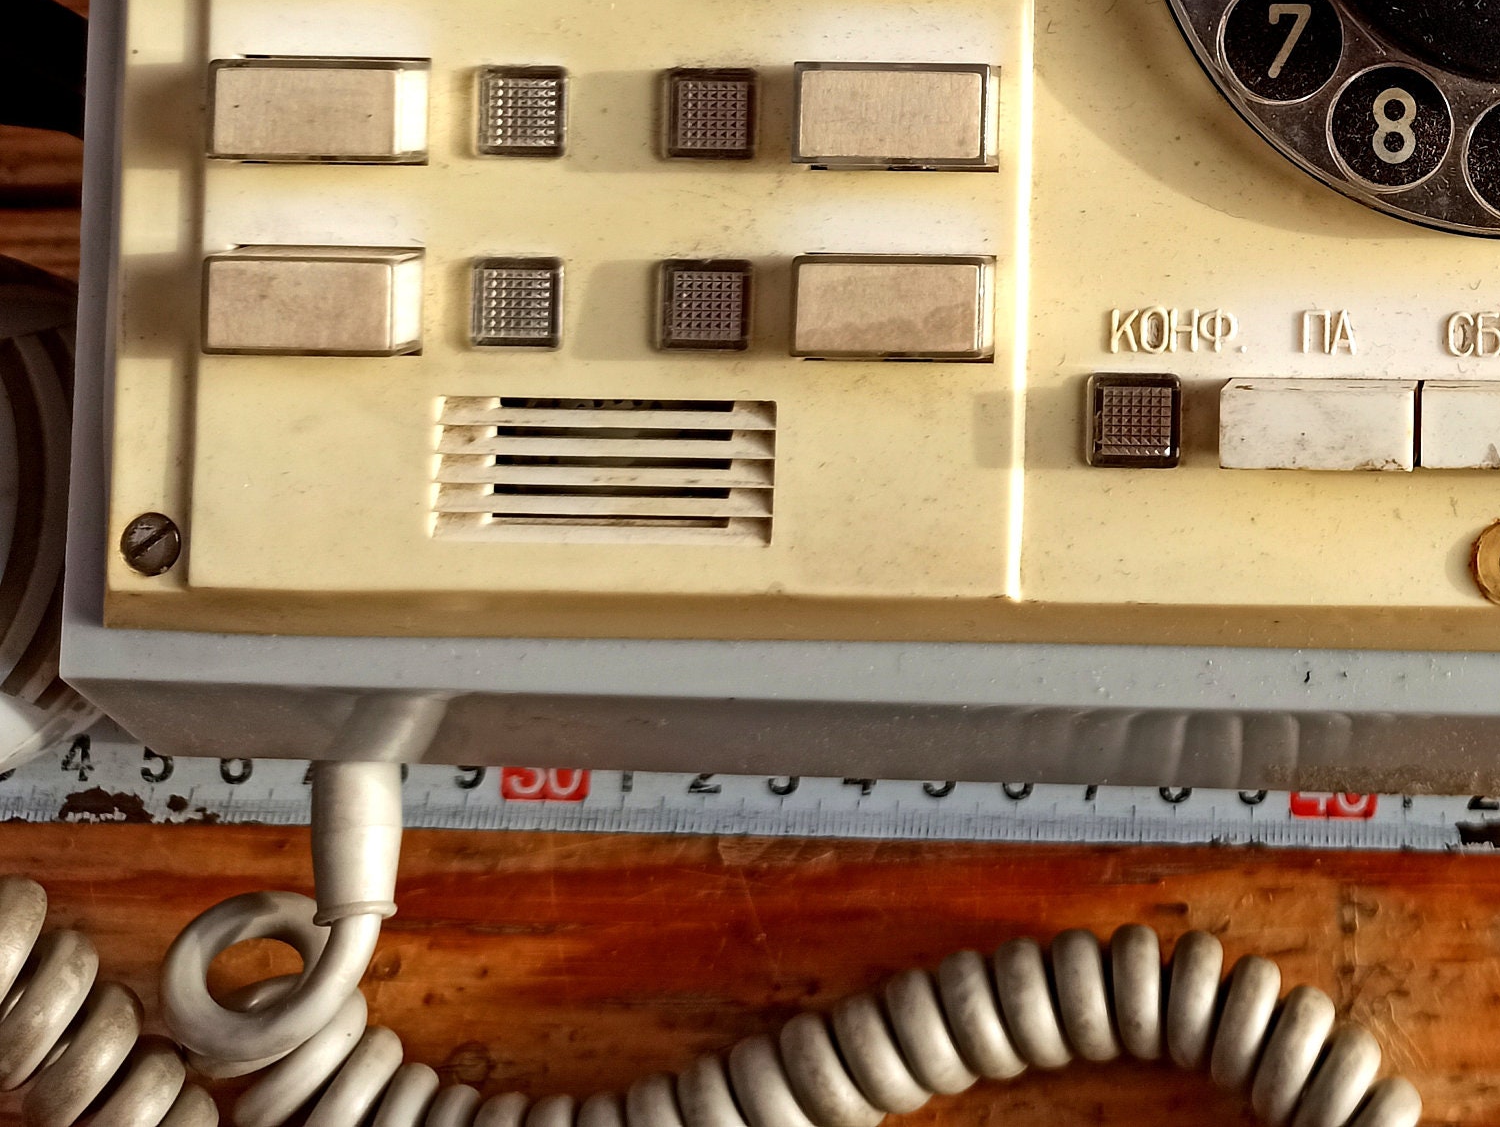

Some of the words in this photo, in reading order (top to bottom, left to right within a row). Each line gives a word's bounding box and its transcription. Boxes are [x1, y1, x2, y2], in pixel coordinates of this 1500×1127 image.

[1267, 3, 1312, 80] 7
[1373, 86, 1417, 165] 8
[1108, 306, 1250, 356] КОНФ.
[1300, 308, 1358, 357] ПА
[61, 732, 95, 782] 4
